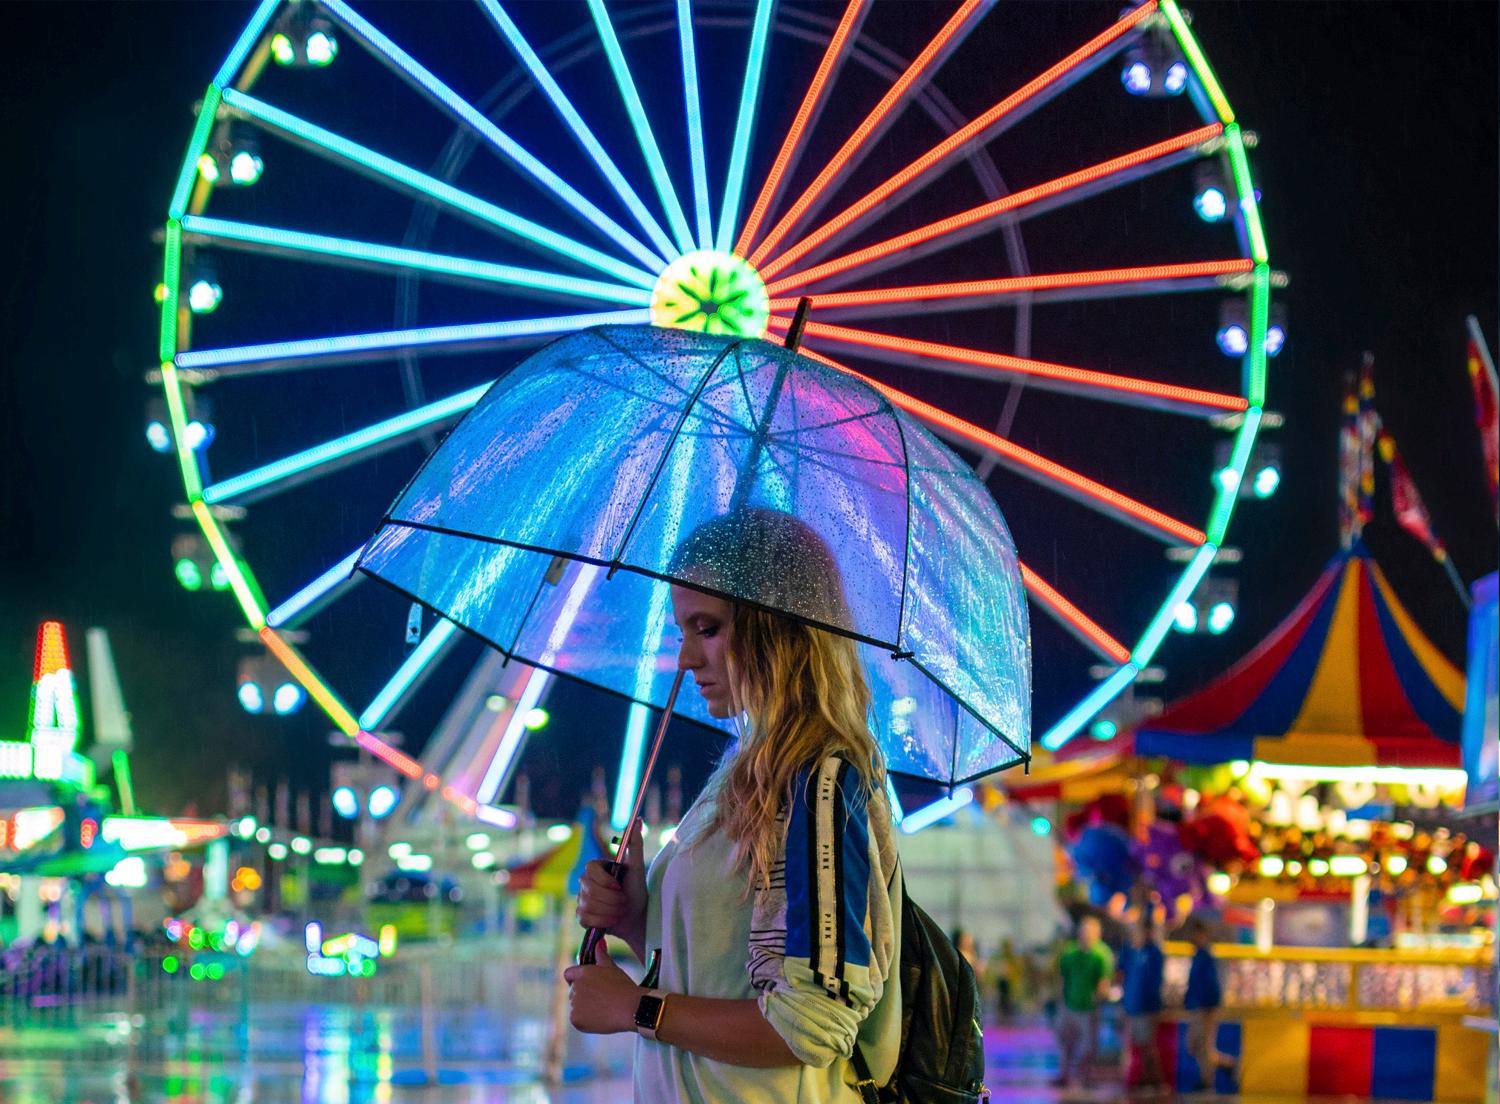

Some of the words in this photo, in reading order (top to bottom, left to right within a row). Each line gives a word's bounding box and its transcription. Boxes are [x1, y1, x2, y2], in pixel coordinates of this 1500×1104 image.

[822, 776, 831, 800] PINK
[822, 844, 830, 870] PINK
[824, 913, 832, 939] PINK
